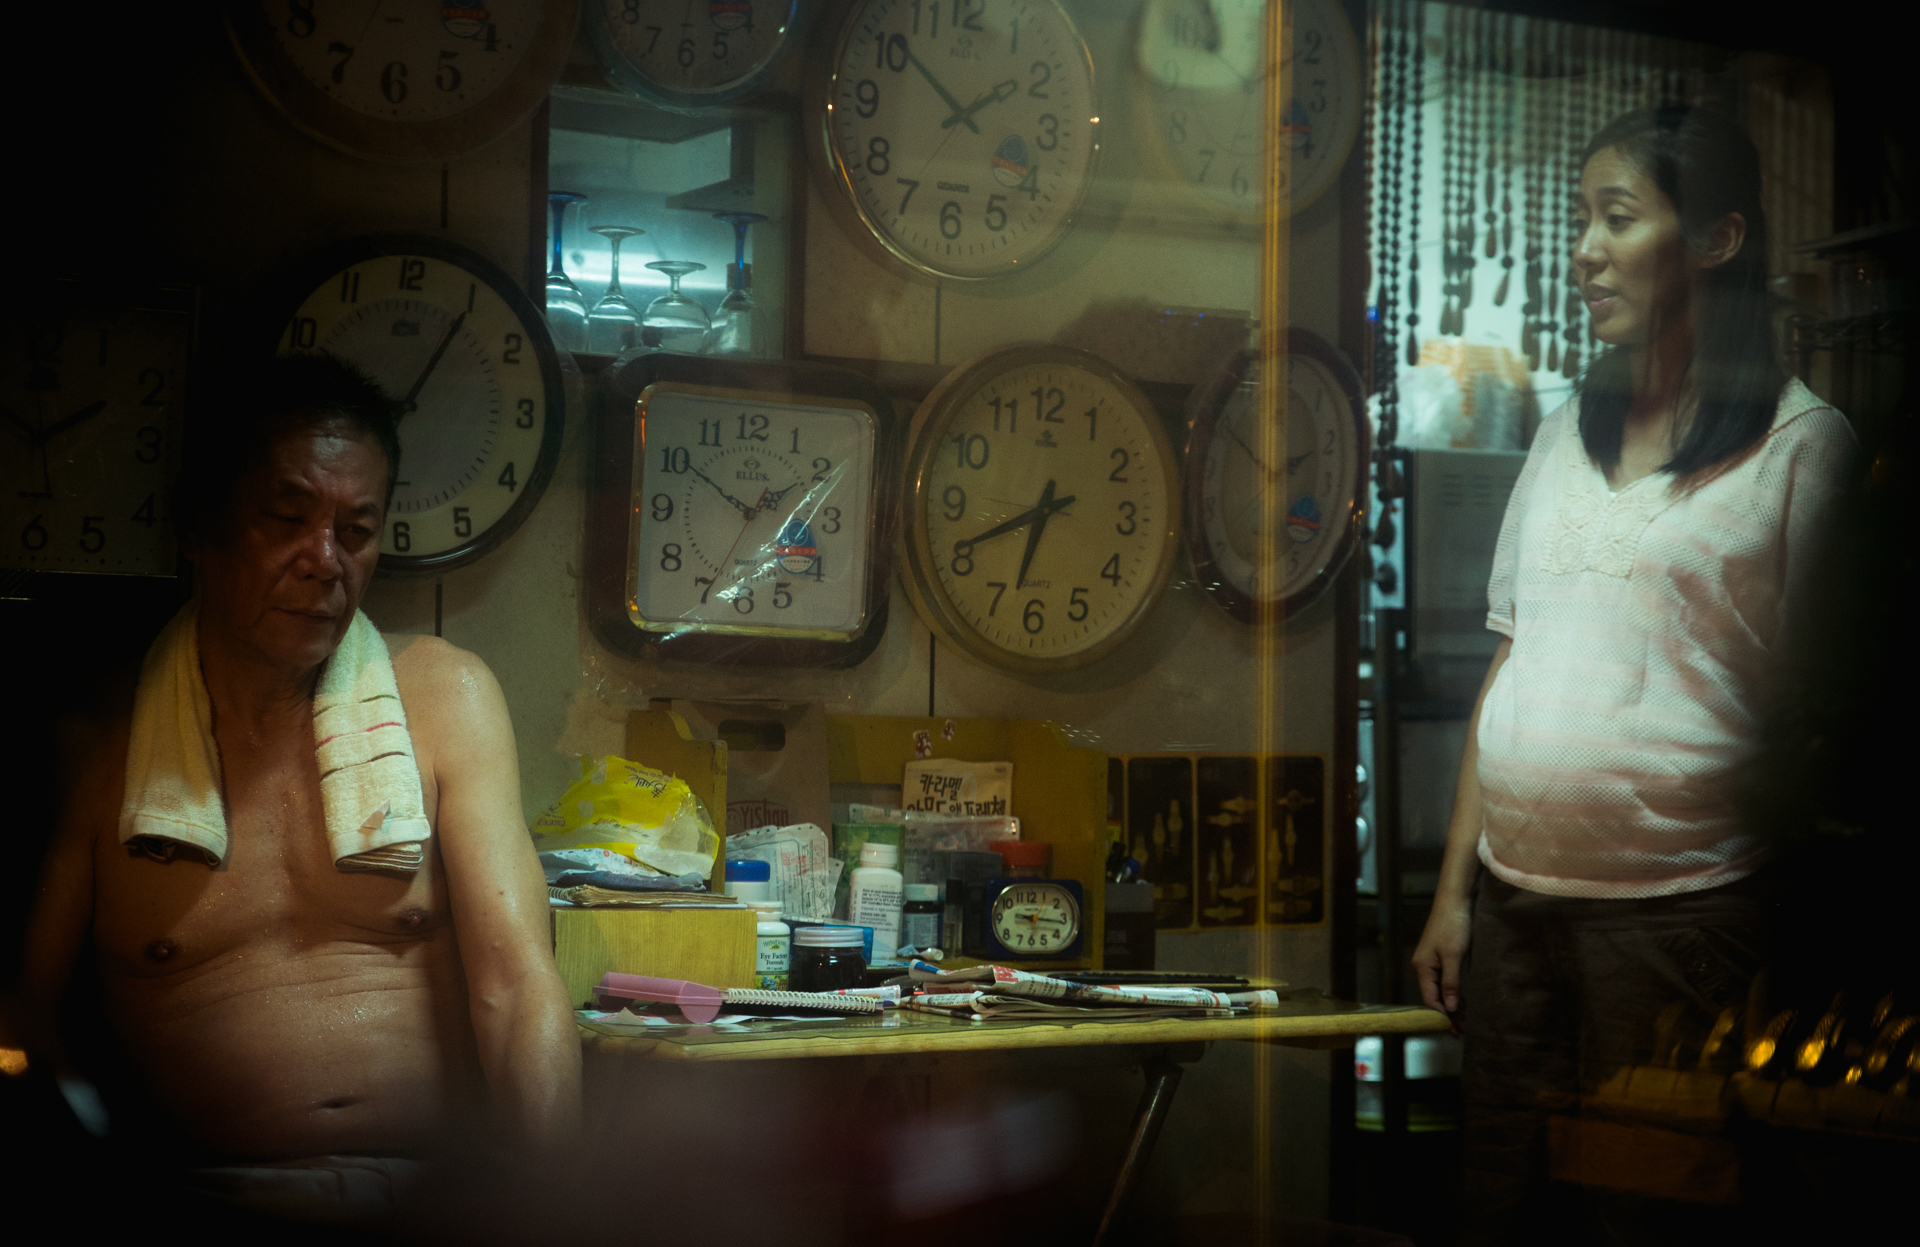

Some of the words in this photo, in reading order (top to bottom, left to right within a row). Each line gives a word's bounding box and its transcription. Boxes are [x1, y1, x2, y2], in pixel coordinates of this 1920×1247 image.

[911, 0, 939, 38] 11
[952, 0, 985, 32] 12
[646, 26, 663, 53] 7
[713, 32, 729, 59] 5
[875, 31, 909, 73] 10
[1008, 17, 1019, 54] 1
[1303, 29, 1322, 65] 2
[328, 41, 355, 84] 7
[678, 38, 695, 67] 6
[380, 61, 408, 104] 6
[434, 50, 462, 92] 5
[1028, 60, 1051, 99] 2
[855, 78, 879, 118] 9
[1311, 79, 1327, 114] 3
[1036, 113, 1059, 151] 3
[866, 136, 890, 176] 8
[896, 177, 919, 215] 7
[1018, 164, 1041, 201] 4
[939, 201, 962, 240] 6
[984, 193, 1007, 232] 5
[341, 271, 360, 303] 11
[399, 258, 425, 291] 12
[467, 283, 476, 313] 1
[96, 328, 109, 366] 1
[290, 316, 317, 350] 10
[503, 333, 523, 364] 2
[138, 368, 166, 407] 2
[516, 398, 534, 429] 3
[988, 397, 1018, 433] 11
[1030, 386, 1065, 423] 12
[698, 418, 723, 447] 11
[736, 412, 770, 442] 12
[1083, 406, 1098, 441] 1
[135, 426, 164, 464] 3
[789, 427, 801, 455] 1
[951, 432, 989, 470] 10
[660, 446, 690, 475] 10
[811, 457, 832, 483] 2
[1109, 448, 1129, 483] 2
[498, 462, 517, 493] 4
[131, 491, 158, 527] 4
[651, 493, 674, 522] 9
[942, 485, 967, 521] 9
[1116, 501, 1137, 536] 3
[21, 514, 49, 551] 6
[79, 516, 106, 553] 5
[392, 521, 411, 552] 6
[453, 507, 472, 538] 5
[821, 506, 841, 534] 3
[660, 543, 682, 572] 8
[804, 555, 826, 582] 4
[951, 539, 974, 576] 8
[1101, 553, 1122, 587] 4
[694, 576, 717, 604] 7
[773, 582, 793, 609] 5
[986, 582, 1007, 617] 7
[1067, 587, 1089, 622] 5
[1022, 598, 1046, 635] 6
[920, 774, 963, 801] 카라멜
[1002, 898, 1013, 910] 10
[1016, 892, 1024, 904] 11
[1027, 892, 1037, 904] 12
[1053, 898, 1060, 910] 2
[996, 913, 1003, 924] 9
[1003, 928, 1010, 941] 8
[1052, 929, 1060, 940] 4
[1060, 913, 1067, 925] 3
[1016, 934, 1024, 945] 7
[1028, 935, 1035, 946] 6
[1040, 934, 1048, 946] 5
